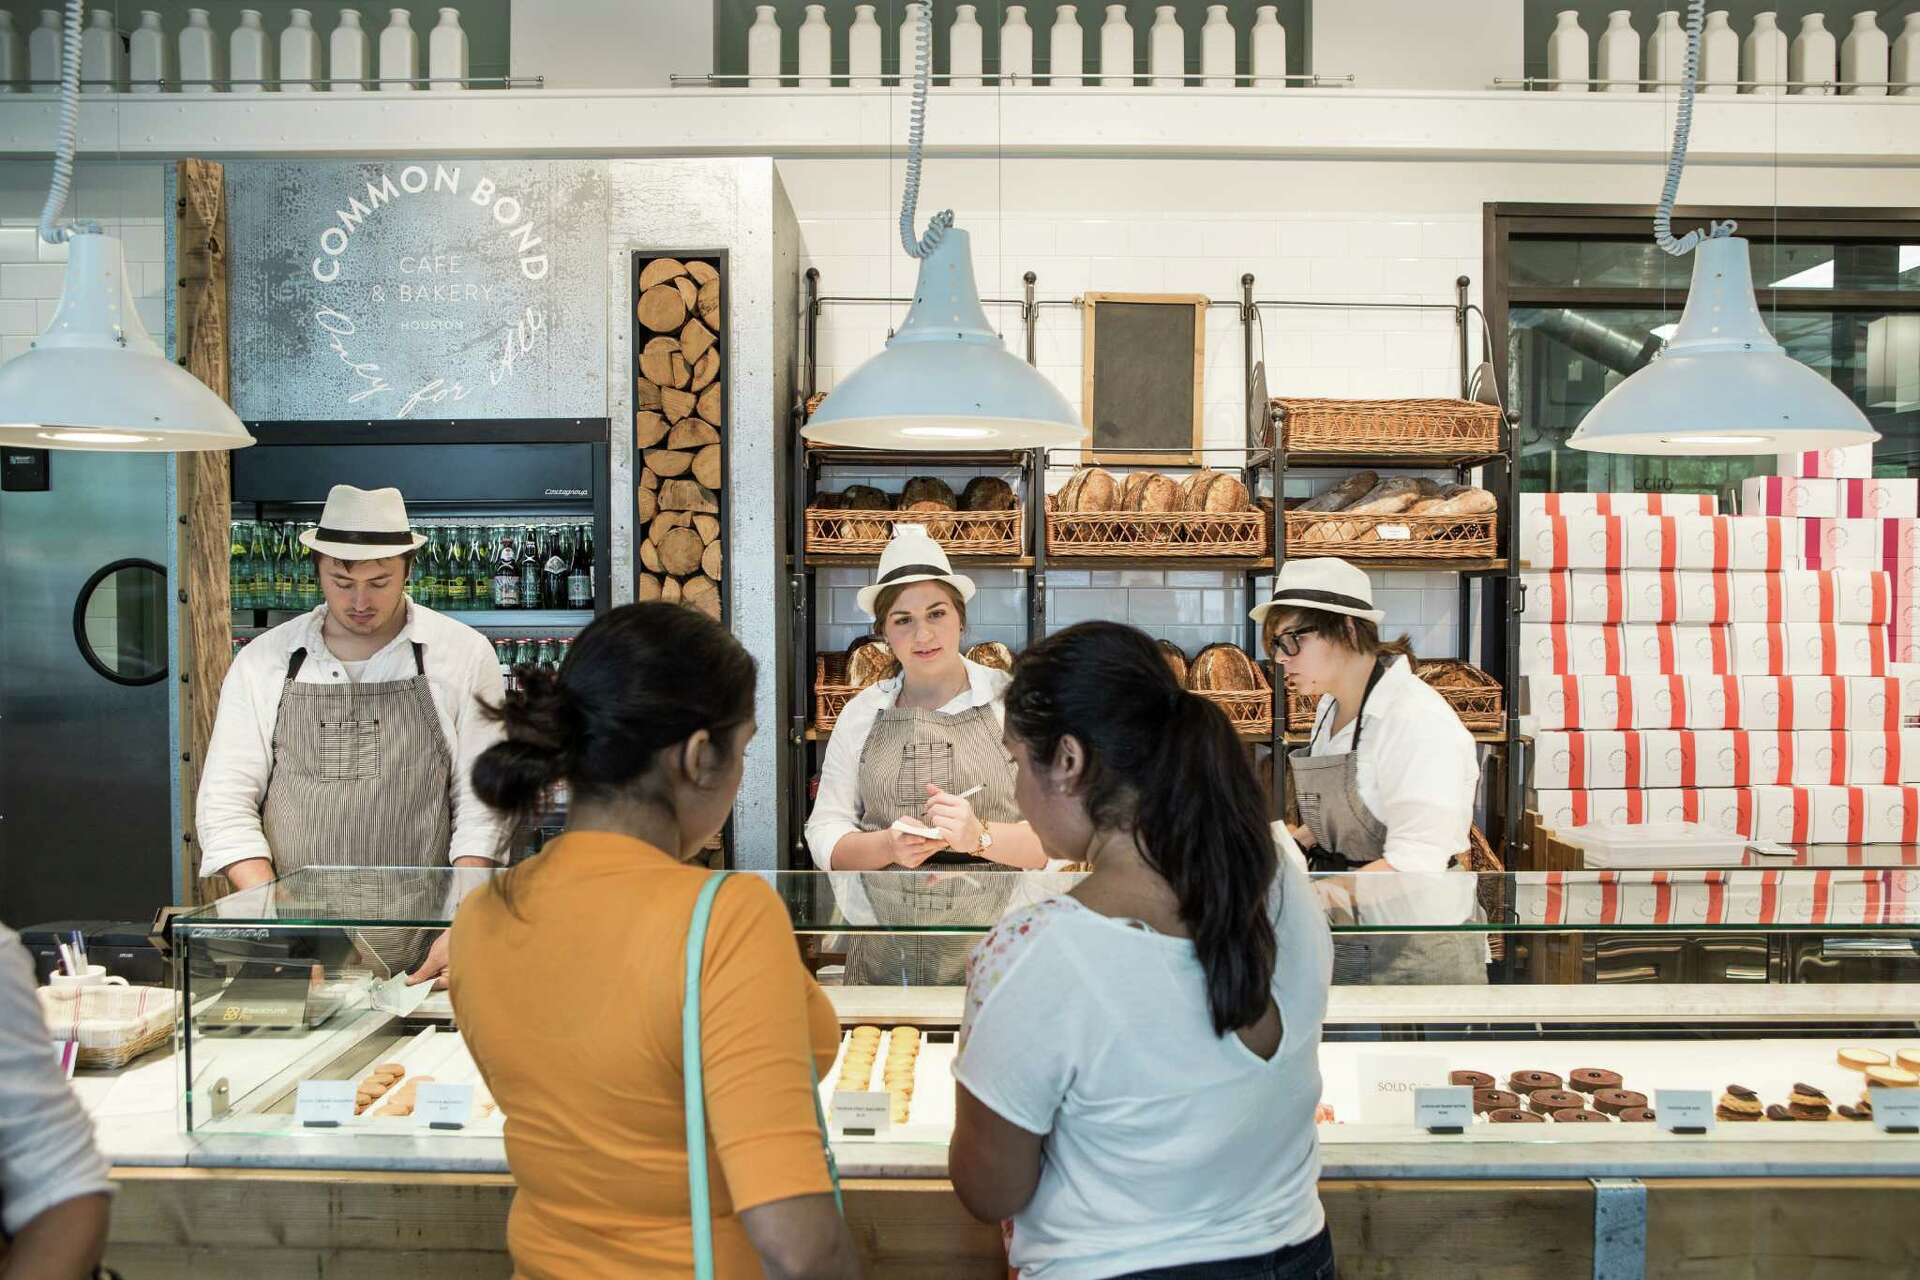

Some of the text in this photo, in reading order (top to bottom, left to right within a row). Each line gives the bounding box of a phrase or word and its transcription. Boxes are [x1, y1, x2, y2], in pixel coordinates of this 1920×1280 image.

[312, 164, 549, 283] COMMON BOND
[371, 283, 495, 302] & BAKERY
[1378, 1081, 1407, 1092] SOLD
